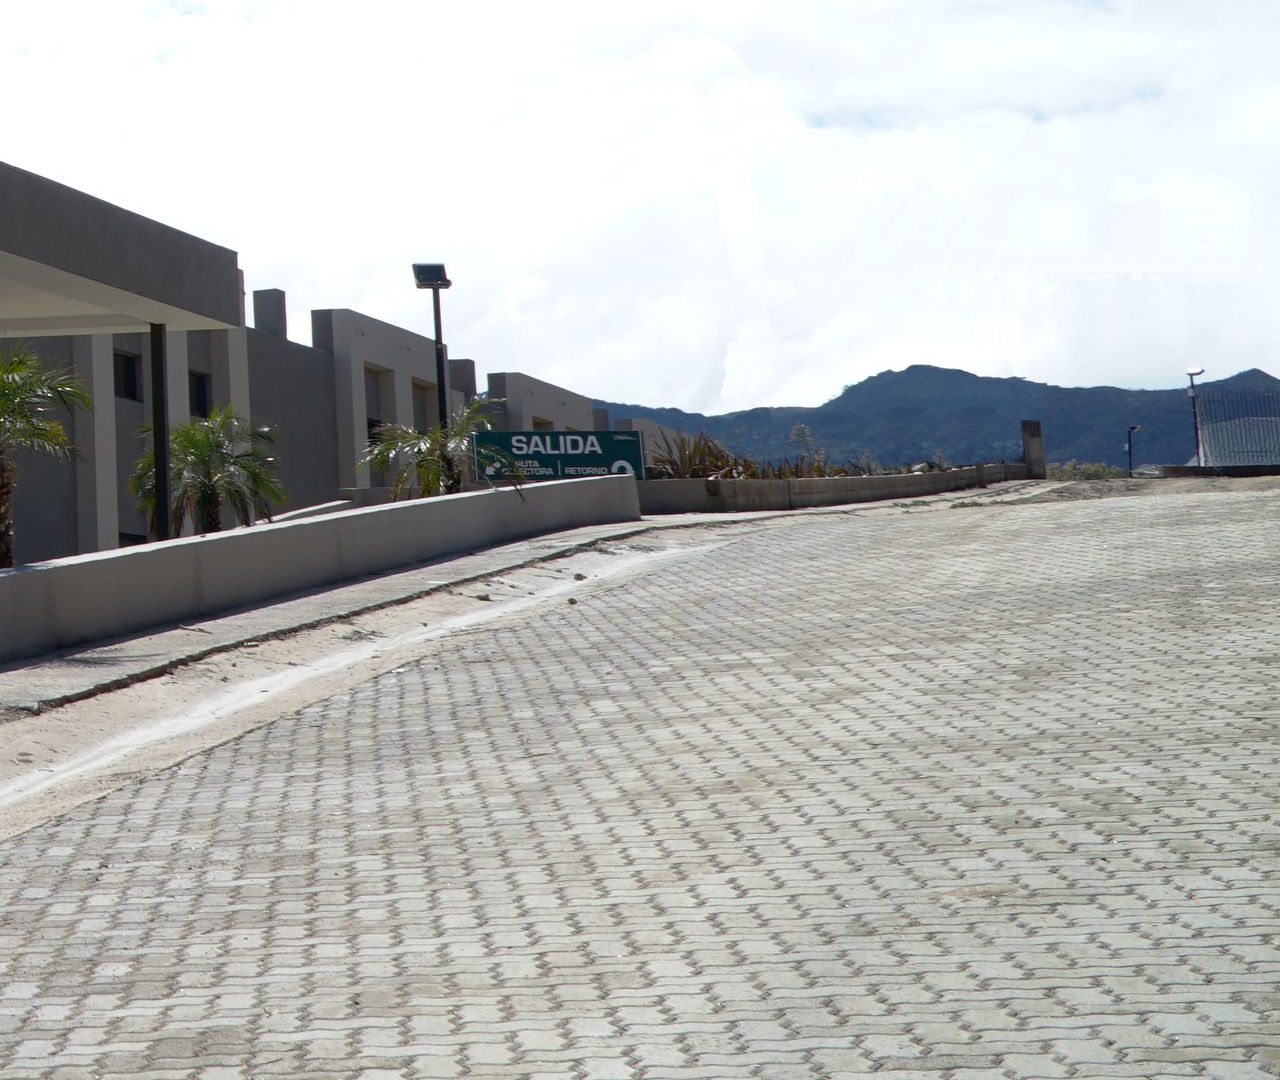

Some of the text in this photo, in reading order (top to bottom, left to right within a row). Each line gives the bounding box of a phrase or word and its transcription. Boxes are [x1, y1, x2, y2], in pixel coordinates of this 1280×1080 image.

[511, 435, 602, 455] SALIDA
[501, 467, 554, 476] CECTORA
[564, 467, 608, 475] RETORNO
